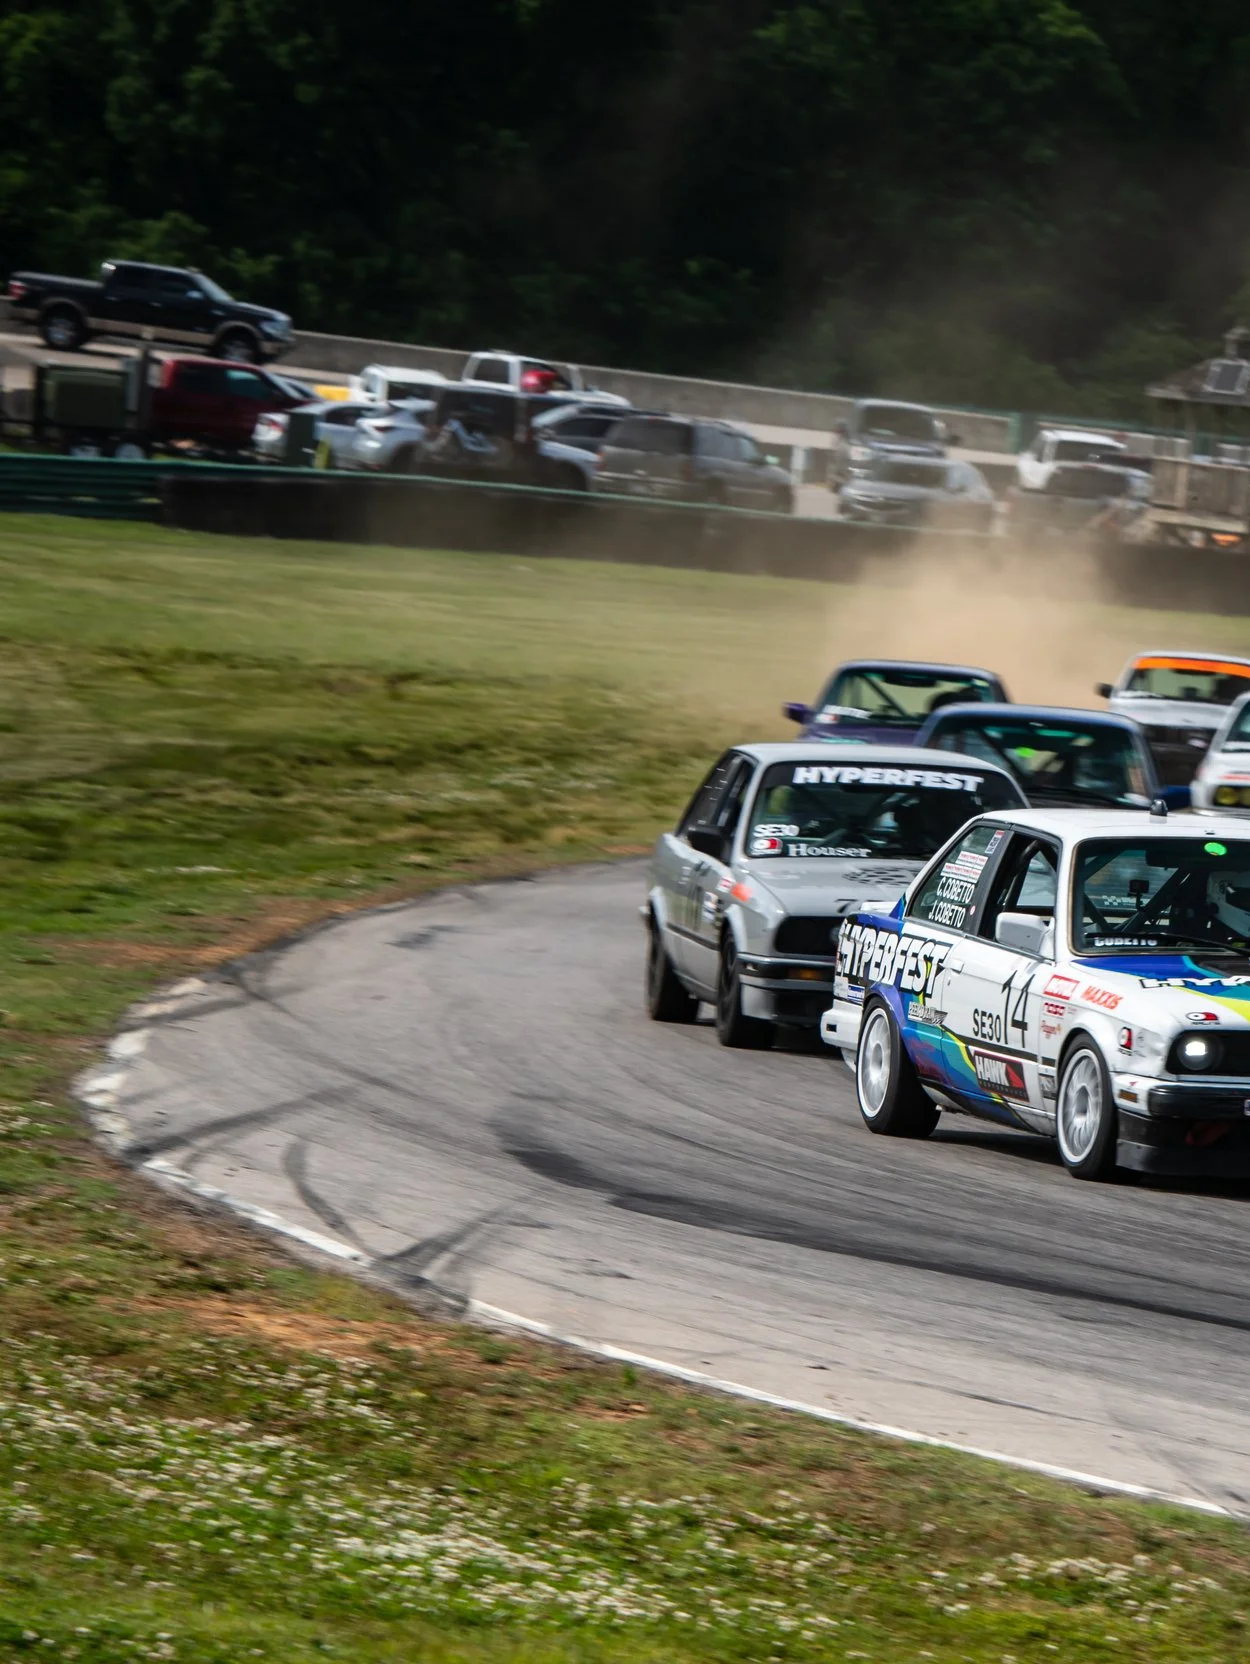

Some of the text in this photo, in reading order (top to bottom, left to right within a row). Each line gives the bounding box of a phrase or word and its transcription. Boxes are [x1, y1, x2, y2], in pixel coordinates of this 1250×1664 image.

[792, 766, 984, 792] HYPERFEST
[752, 824, 799, 837] SE30
[787, 843, 872, 857] Houser
[942, 878, 975, 904] COBETTO
[934, 901, 966, 928] COBETTO
[836, 917, 952, 995] HYPERFEST
[1001, 969, 1036, 1049] 14
[1080, 985, 1124, 1010] MAXXIS
[972, 1008, 1001, 1043] SE30
[974, 1054, 1010, 1087] HAWK
